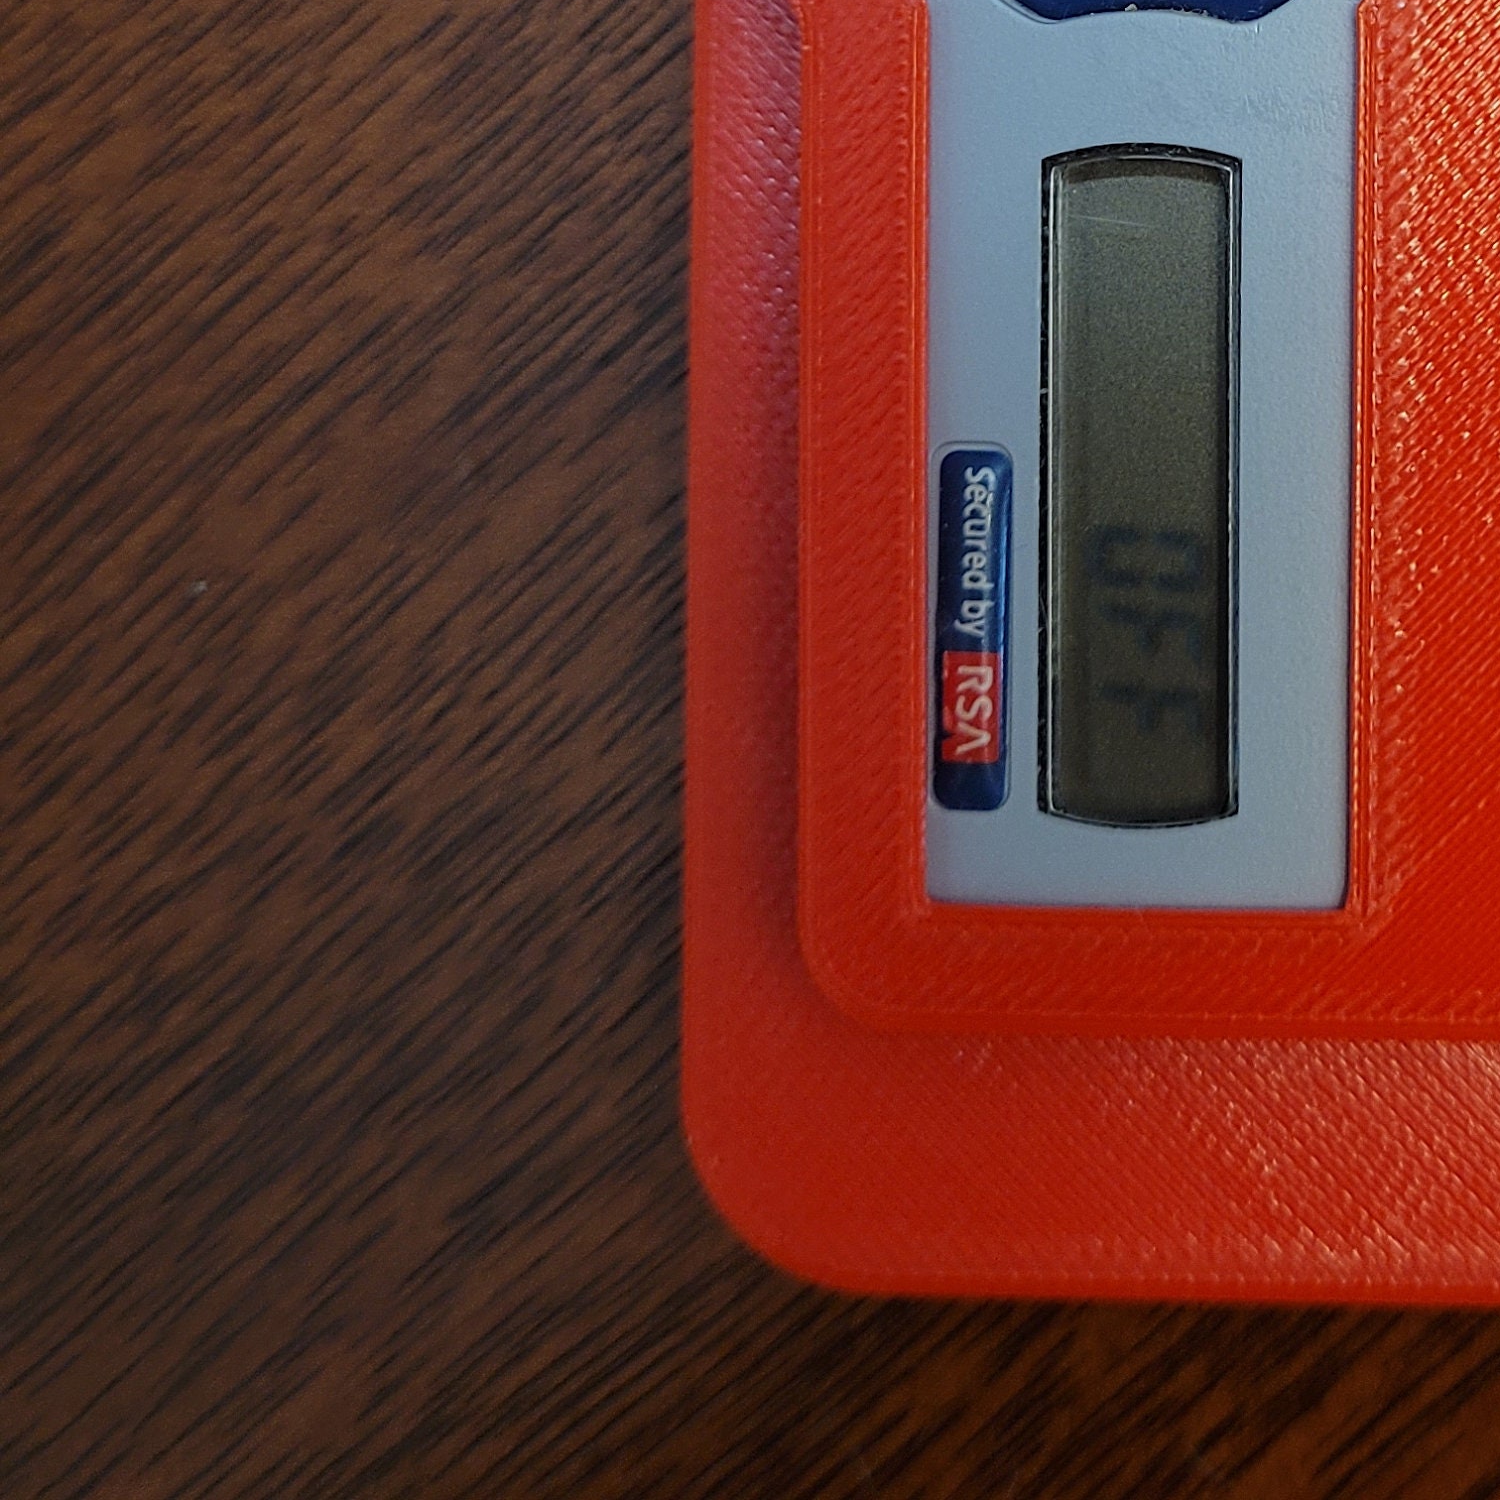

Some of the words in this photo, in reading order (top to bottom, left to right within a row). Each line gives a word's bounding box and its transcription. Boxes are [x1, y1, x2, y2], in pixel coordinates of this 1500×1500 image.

[962, 466, 997, 590] Secured
[956, 599, 994, 636] by
[954, 665, 993, 756] RSA
